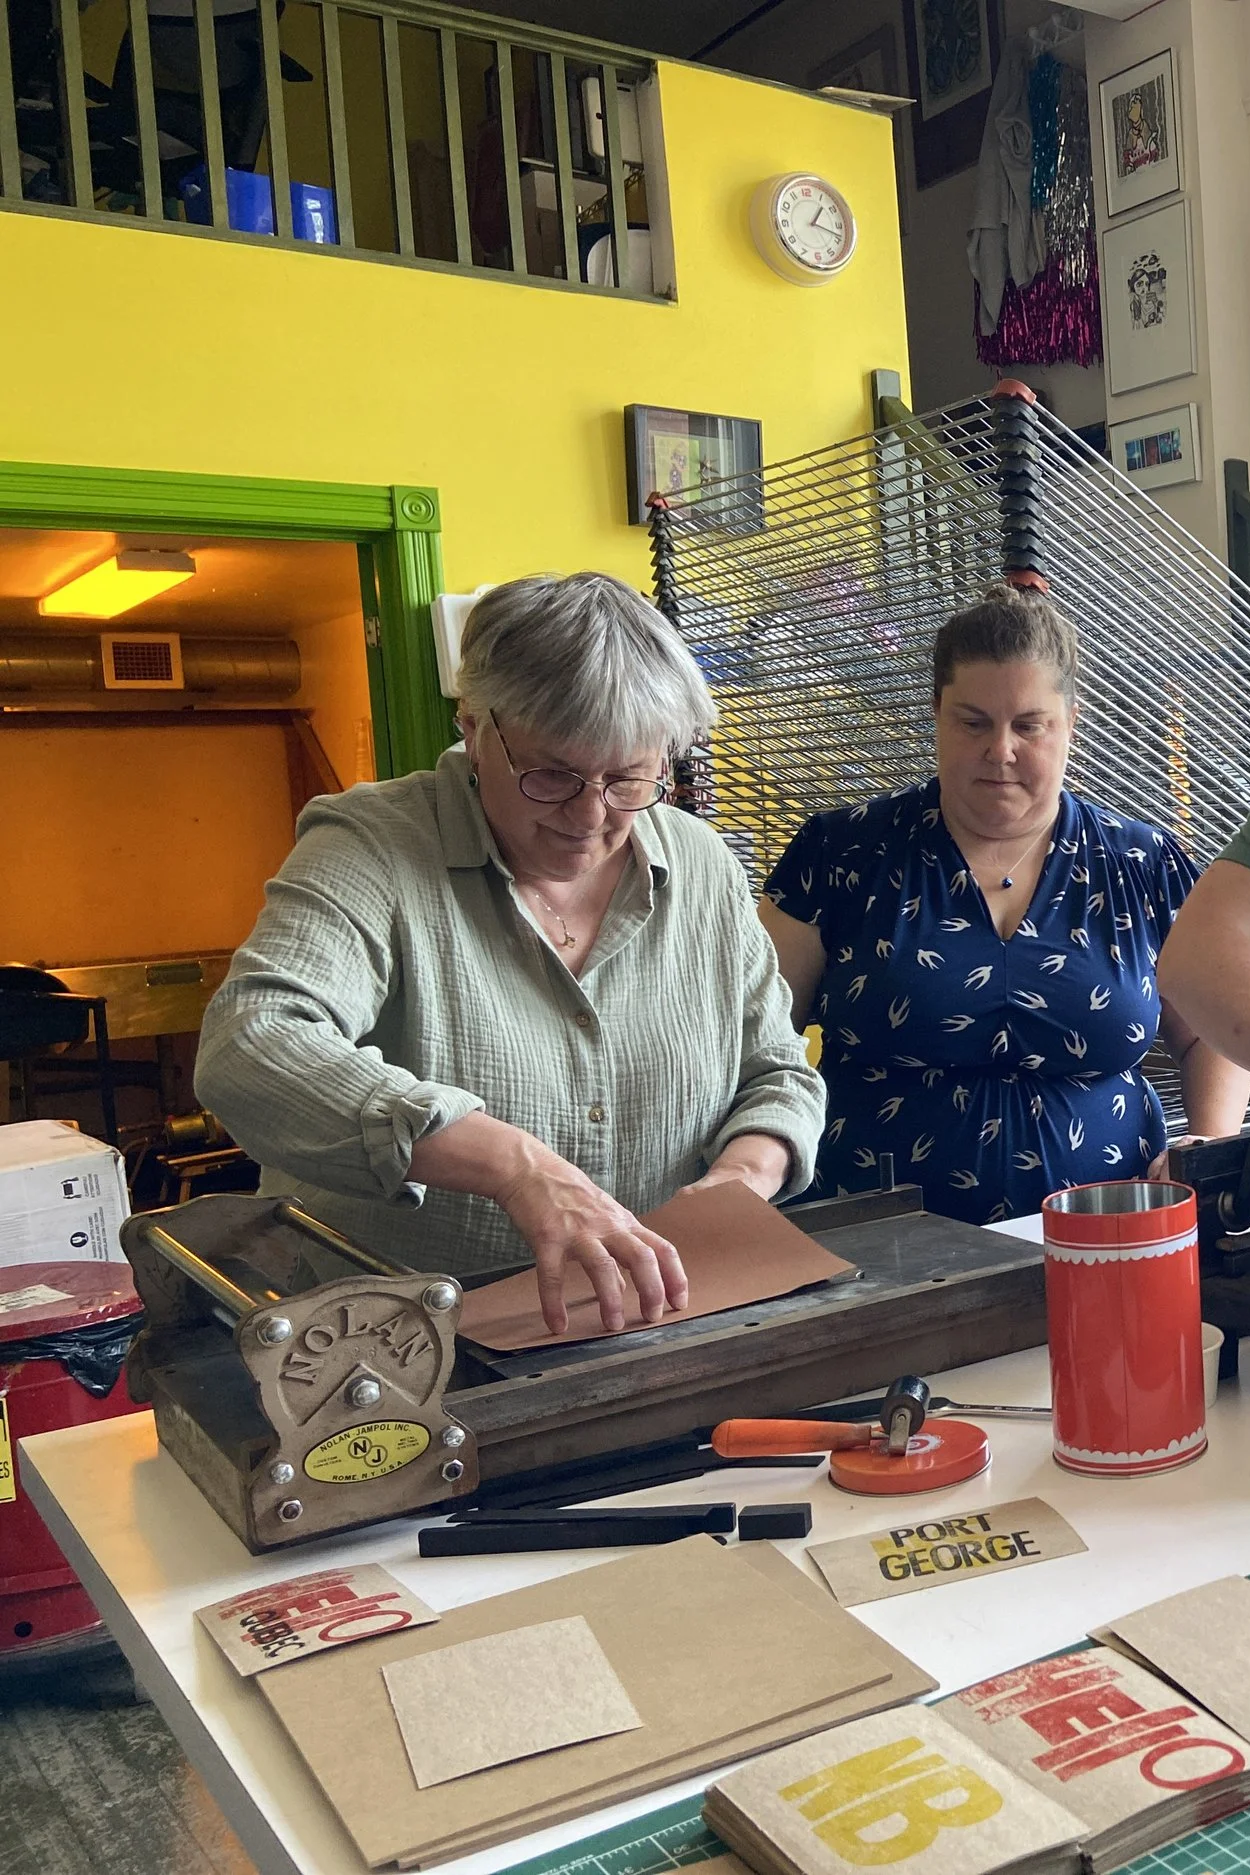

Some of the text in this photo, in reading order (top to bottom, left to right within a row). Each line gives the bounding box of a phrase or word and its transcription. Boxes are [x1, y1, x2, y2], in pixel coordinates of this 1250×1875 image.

[789, 191, 798, 201] 11
[801, 188, 812, 198] 12
[781, 201, 791, 213] 10
[828, 204, 837, 214] 2
[781, 219, 790, 228] 9
[835, 221, 843, 230] 3
[787, 235, 797, 244] 8
[834, 236, 842, 245] 4
[800, 247, 808, 256] 7
[814, 252, 822, 261] 6
[826, 247, 836, 257] 5
[284, 1303, 435, 1386] NOLAN
[353, 1439, 381, 1463] N J
[890, 1512, 993, 1549] PORT
[879, 1530, 1041, 1581] GEORGE
[777, 1735, 1004, 1867] NB
